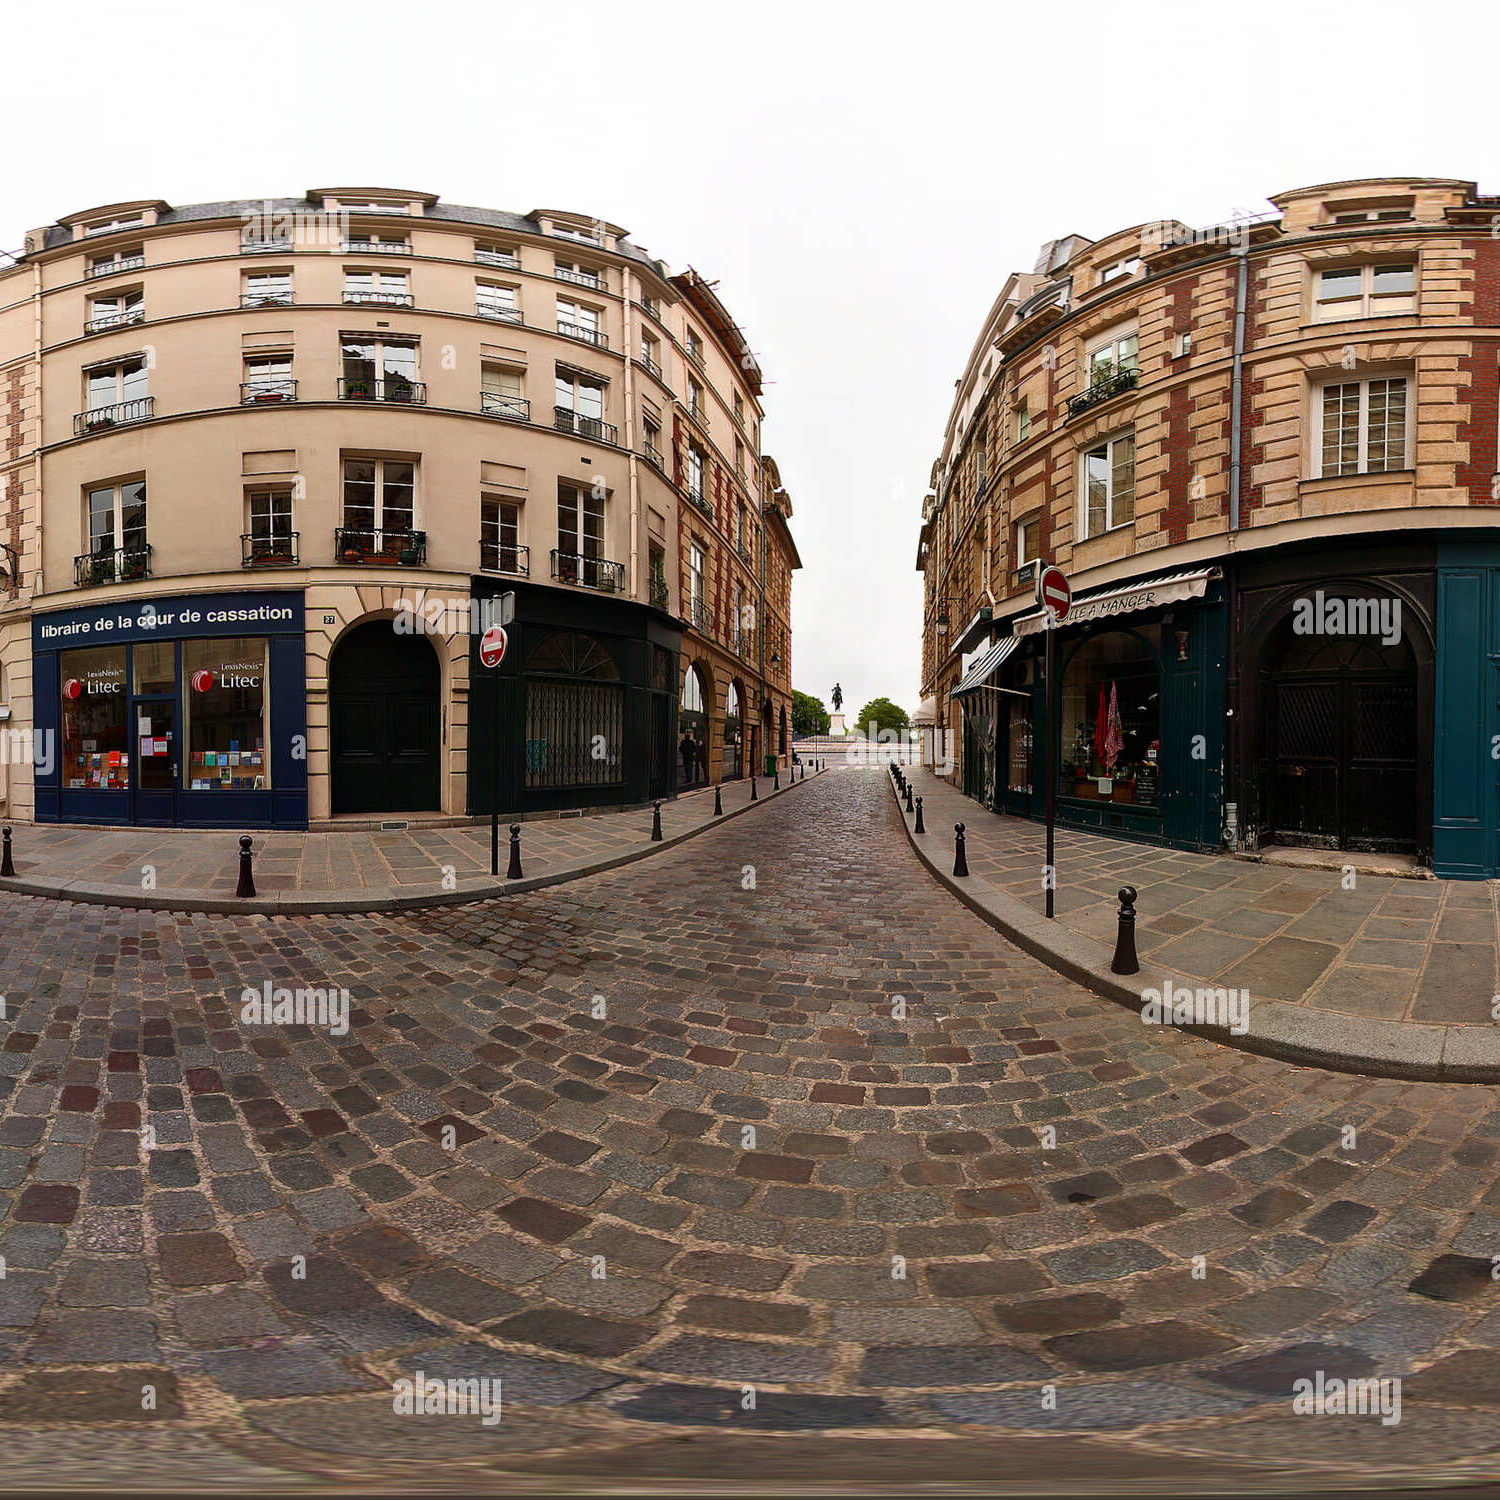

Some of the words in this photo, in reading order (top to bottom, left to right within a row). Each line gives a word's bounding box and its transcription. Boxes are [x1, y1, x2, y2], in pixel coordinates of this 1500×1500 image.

[1100, 592, 1156, 613] MANGER
[41, 621, 91, 638] libraire
[94, 617, 114, 632] de
[117, 615, 133, 629] la
[136, 612, 175, 628] cour
[179, 608, 202, 623] de
[206, 605, 293, 623] cassation
[324, 616, 334, 624] 27
[87, 680, 121, 694] Litec
[221, 673, 260, 688] Litec
